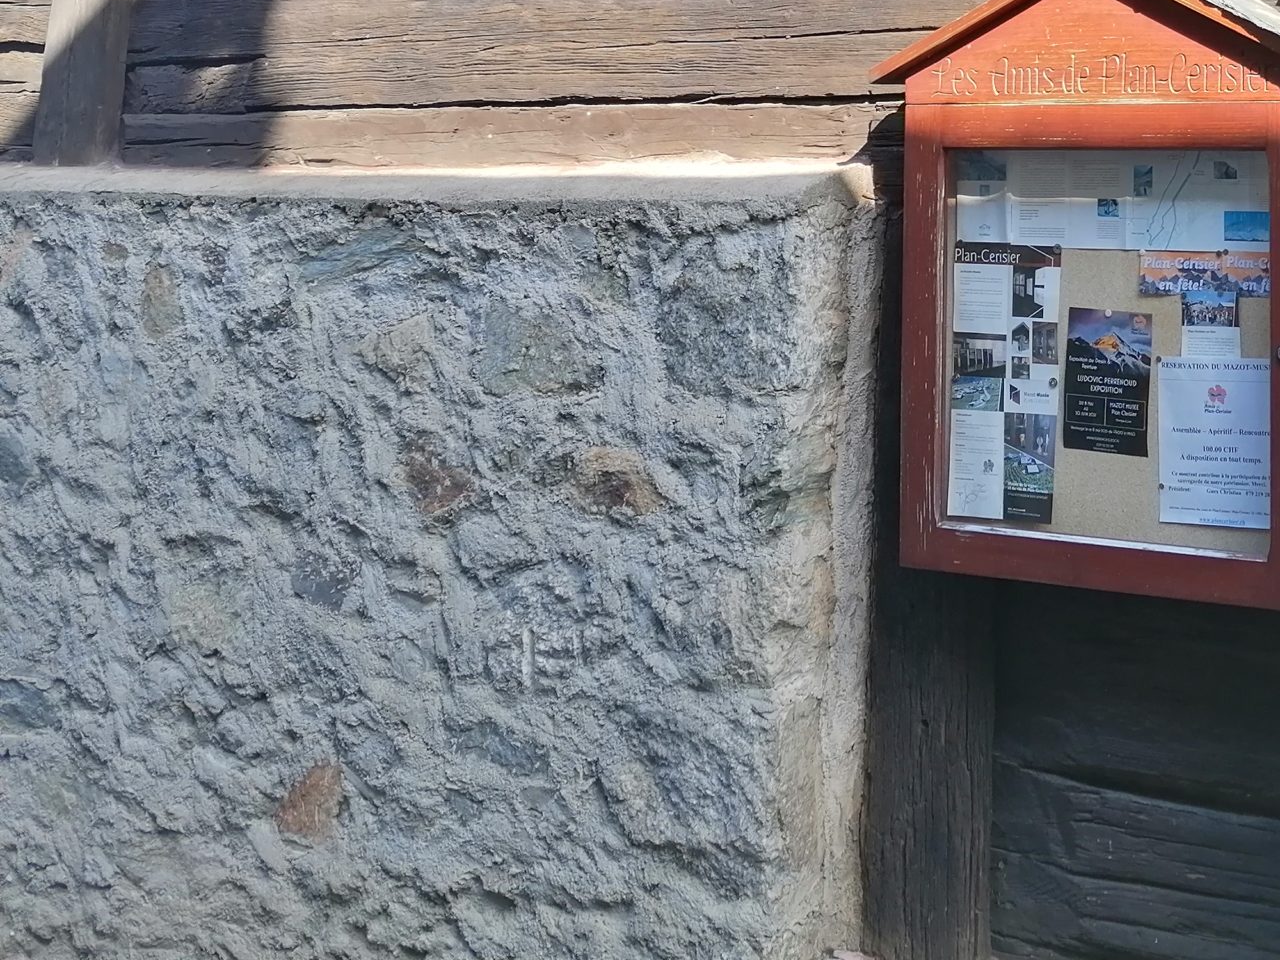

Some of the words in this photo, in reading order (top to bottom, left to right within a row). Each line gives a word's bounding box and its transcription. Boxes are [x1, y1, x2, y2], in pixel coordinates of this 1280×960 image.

[930, 56, 978, 98] Les
[988, 54, 1055, 96] Amis
[1061, 53, 1090, 95] de
[1098, 52, 1272, 95] Plan-Cerisier
[954, 248, 1021, 264] Plan-Cerisier
[1143, 256, 1222, 270] Plan-Cerisier
[1159, 281, 1172, 290] en
[1175, 279, 1203, 293] fête!
[1242, 281, 1257, 291] en
[1077, 374, 1103, 383] LUDOVIC
[1104, 377, 1138, 387] PERRENOUD
[1090, 384, 1123, 394] EXPOSITION
[1171, 426, 1201, 434] Assemblée
[1209, 428, 1233, 436] Apéritif
[1223, 446, 1239, 454] CHF
[1186, 454, 1219, 462] disposition
